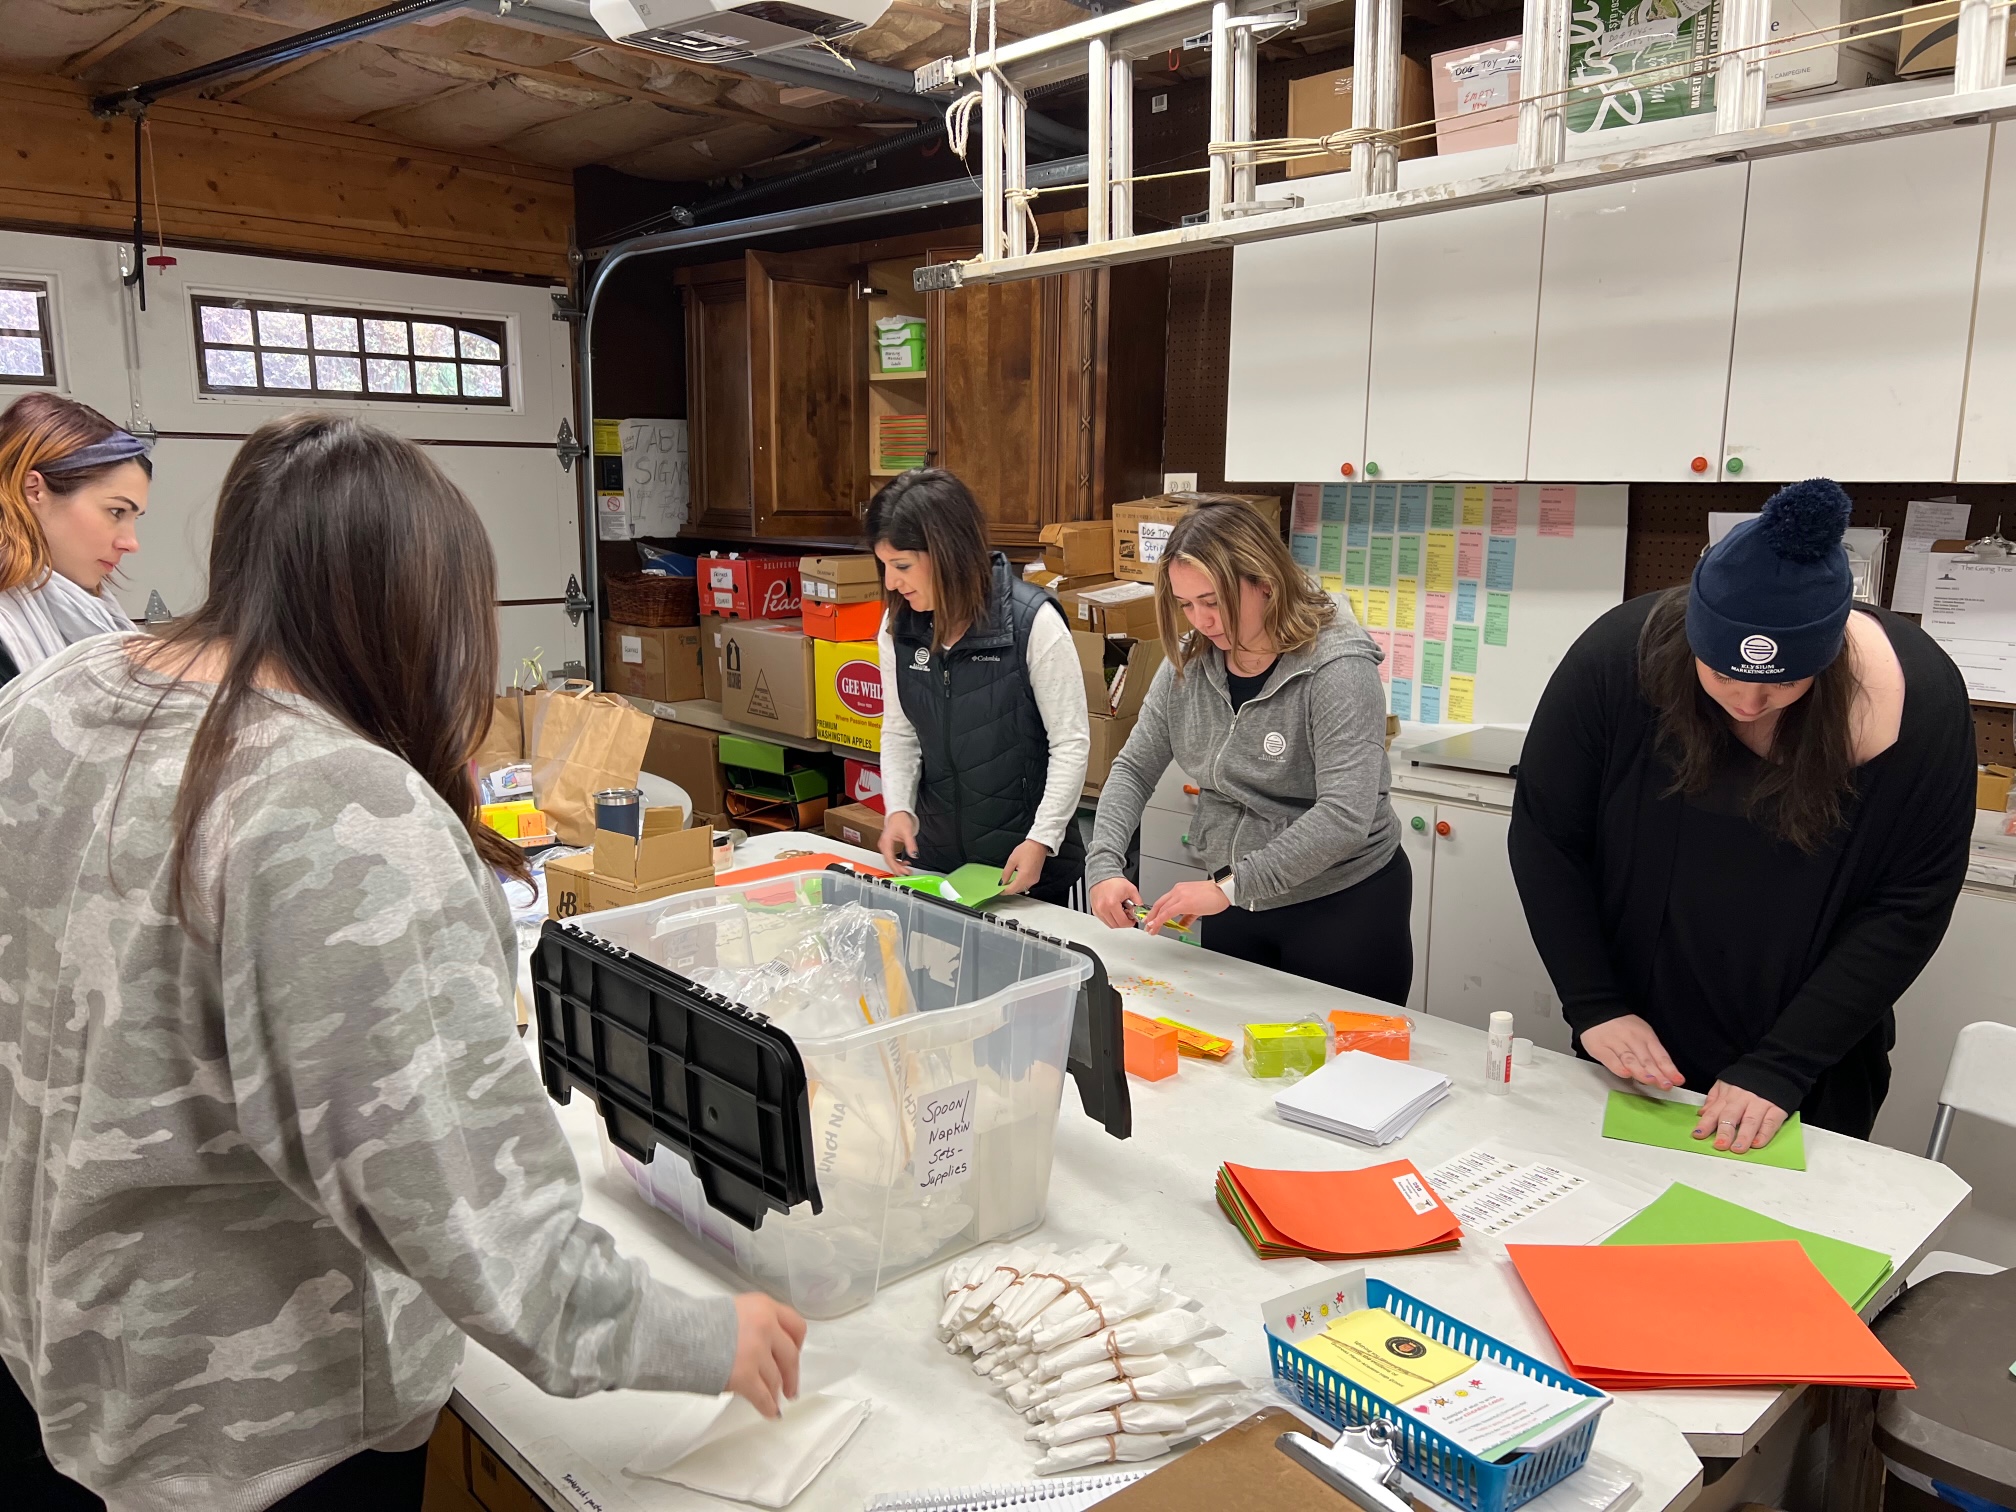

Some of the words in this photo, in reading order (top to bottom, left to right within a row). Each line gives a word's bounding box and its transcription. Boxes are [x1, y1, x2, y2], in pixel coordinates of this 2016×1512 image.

[1455, 66, 1475, 76] DOG
[1481, 59, 1499, 69] TOY
[1691, 83, 1701, 109] MAKE
[1696, 14, 1707, 40] CLEAR
[1774, 66, 1811, 79] CAMPEGINE
[1464, 88, 1495, 104] EMPTY
[630, 424, 688, 454] TABL
[1142, 526, 1156, 537] DOG
[763, 559, 799, 570] DELIVERIN
[1975, 565, 1996, 574] Giving
[762, 579, 801, 616] Peac
[1731, 665, 1765, 674] MARKETING
[841, 677, 860, 695] GEE
[816, 719, 838, 731] PREMIUM
[835, 714, 849, 723] Where
[849, 717, 868, 727] Passion
[816, 729, 851, 745] WASHINGTON
[851, 735, 872, 750] APPLES
[920, 1162, 968, 1187] Supplies
